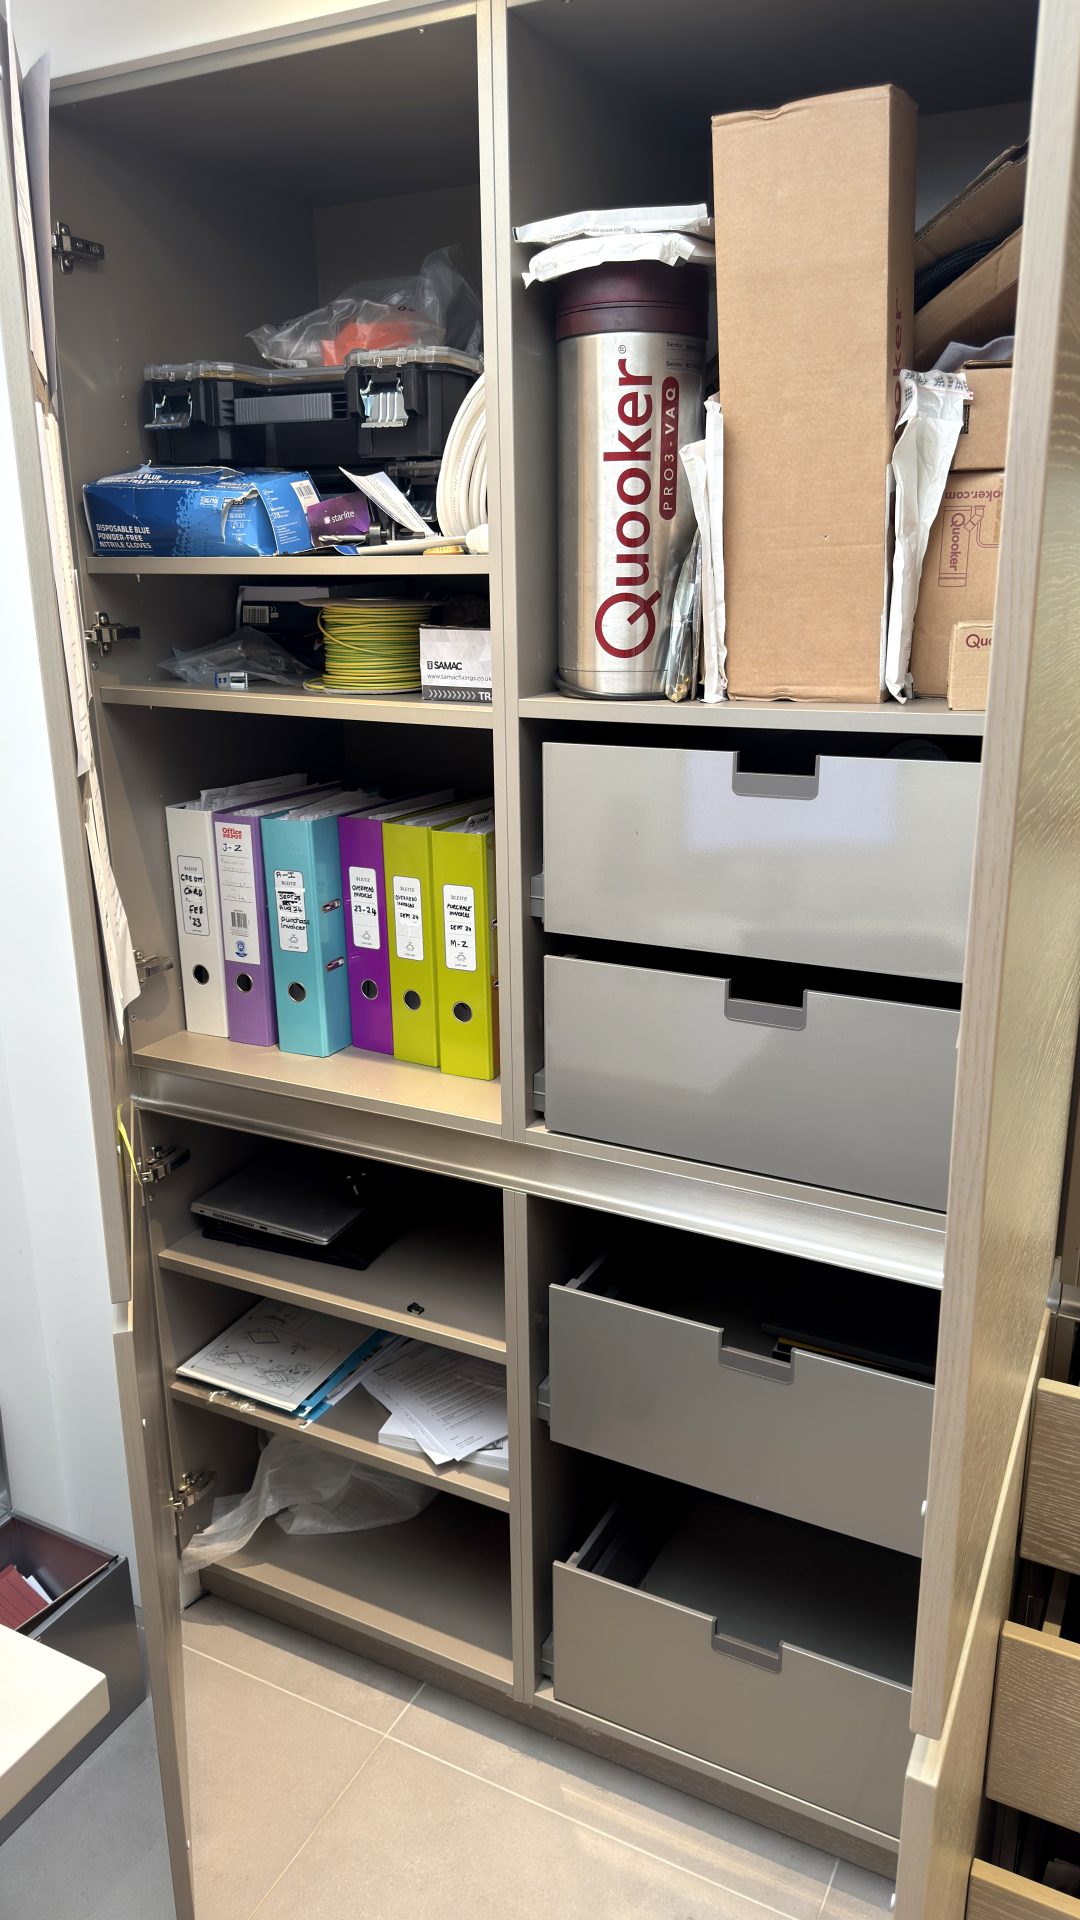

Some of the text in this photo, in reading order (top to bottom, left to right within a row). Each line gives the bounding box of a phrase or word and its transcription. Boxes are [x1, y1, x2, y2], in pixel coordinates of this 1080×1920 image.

[595, 358, 662, 658] Quooker
[96, 524, 133, 533] DISPOSABLE
[99, 541, 126, 549] NITRILE
[949, 512, 965, 571] Quooker
[434, 660, 463, 671] SAMAC
[478, 691, 492, 701] TR
[189, 904, 203, 915] FEB
